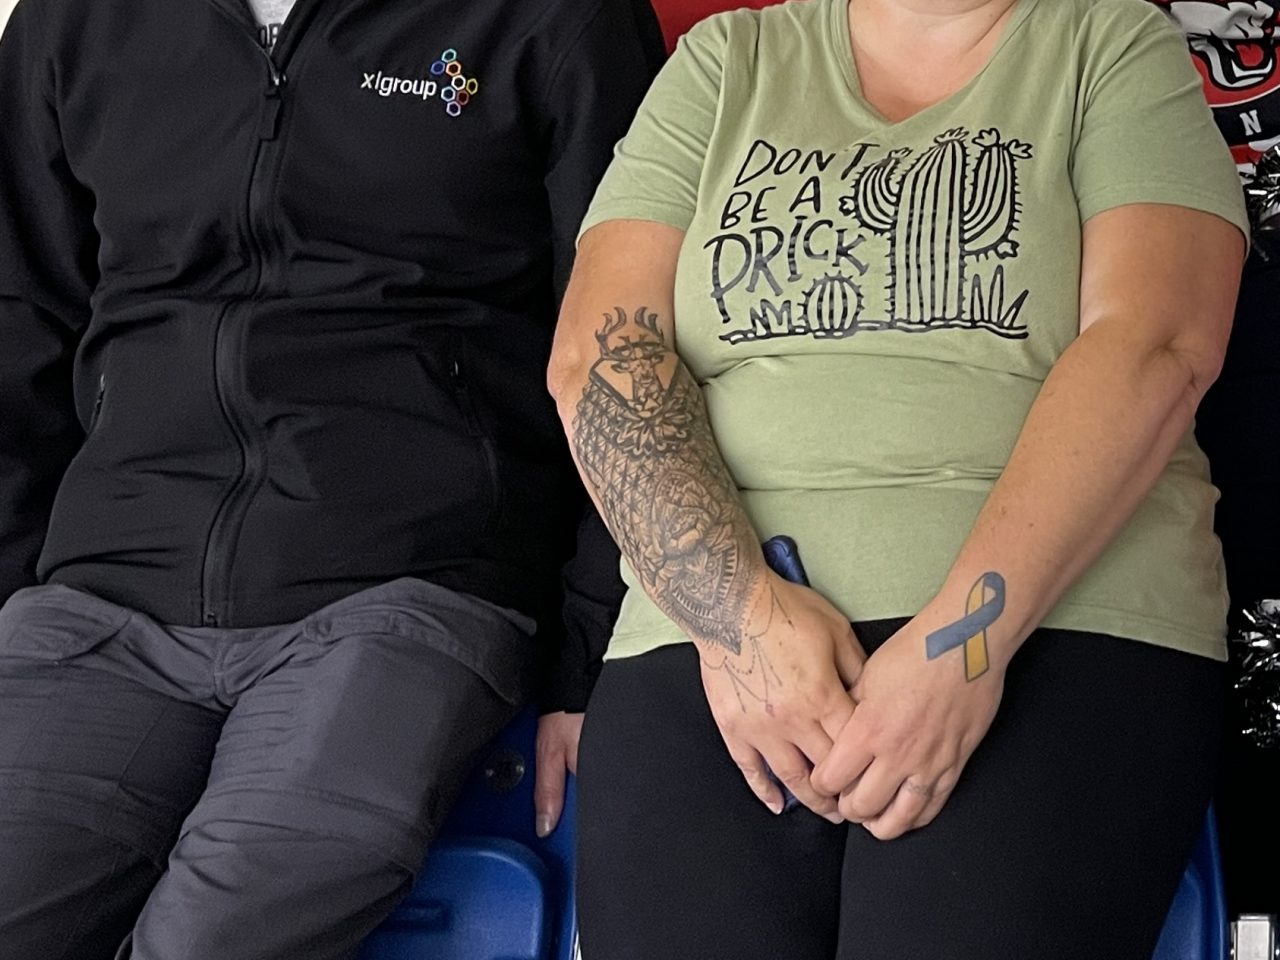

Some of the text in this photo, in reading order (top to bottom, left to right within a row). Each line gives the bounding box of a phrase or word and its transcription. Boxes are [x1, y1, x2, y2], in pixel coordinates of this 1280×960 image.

[361, 71, 437, 100] xlgroup
[734, 139, 881, 187] DONT
[720, 176, 821, 229] BE A
[703, 215, 869, 323] PRICK
